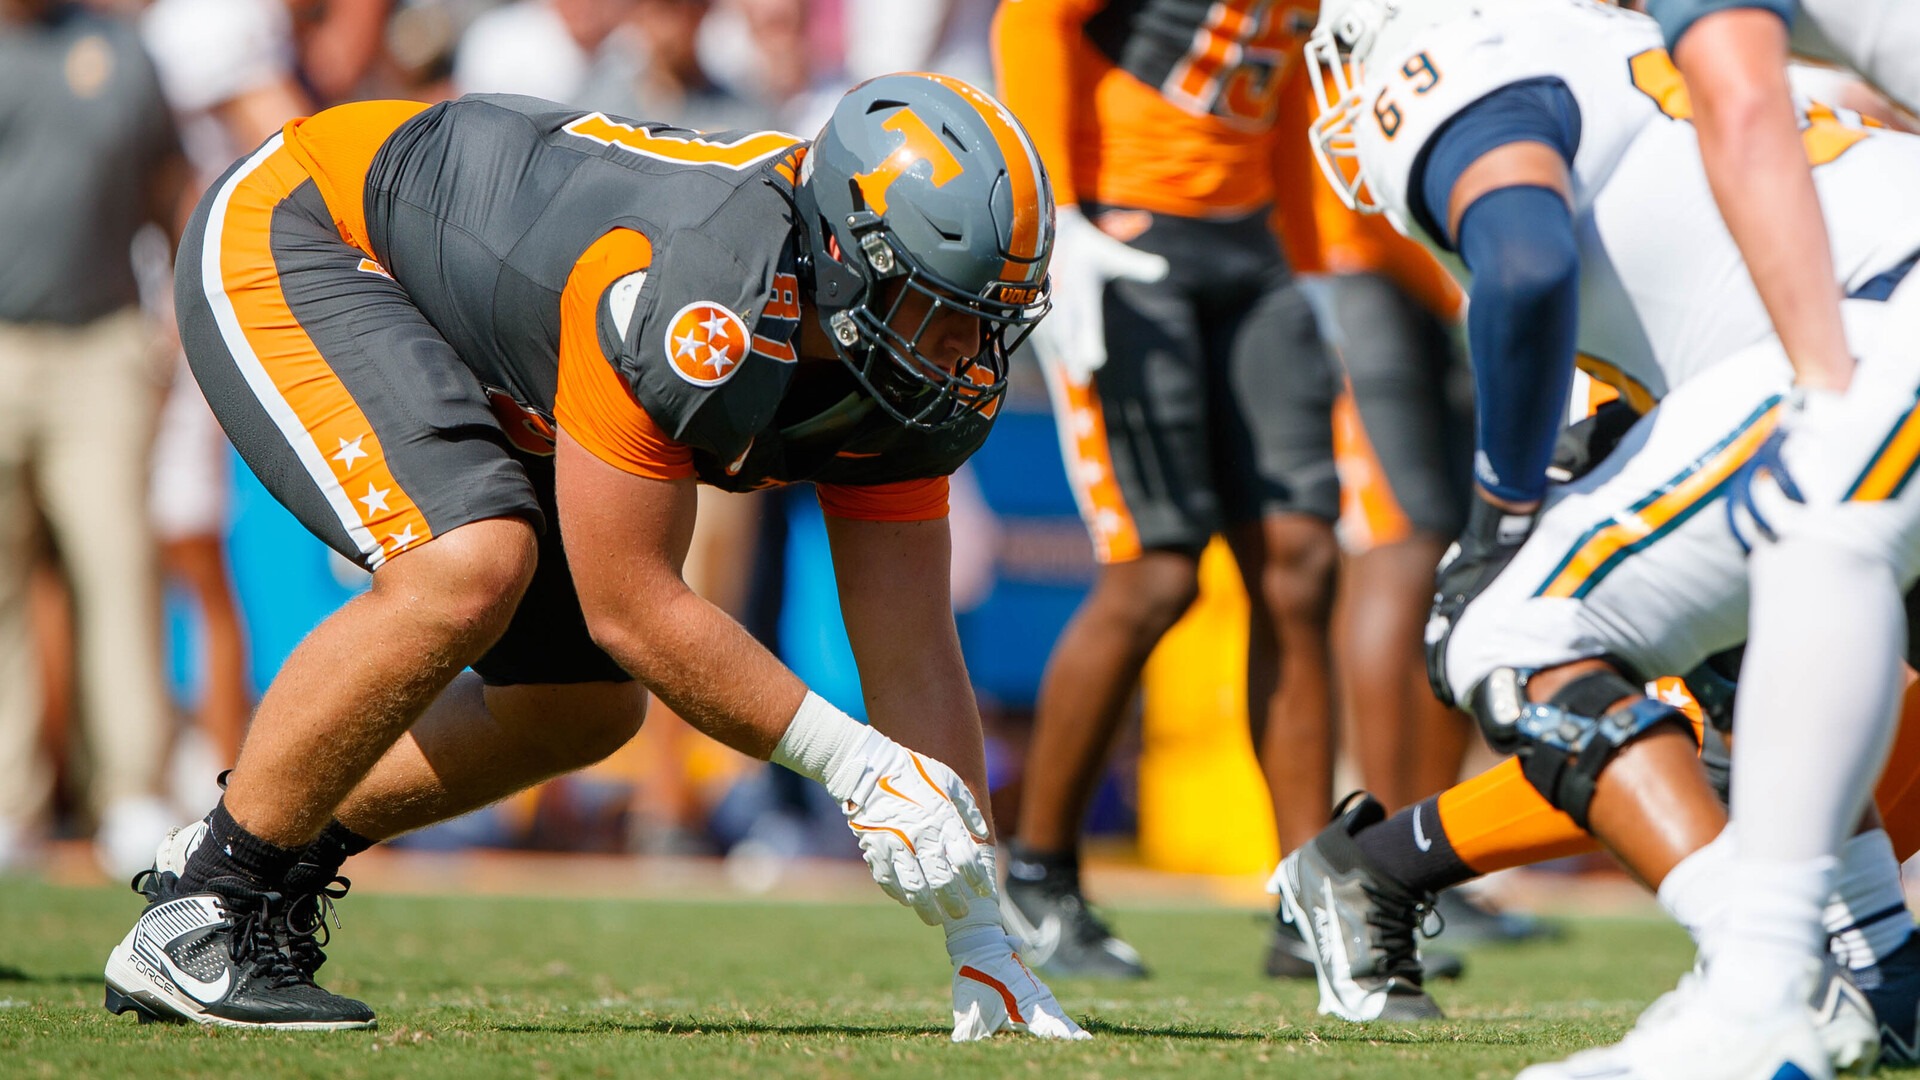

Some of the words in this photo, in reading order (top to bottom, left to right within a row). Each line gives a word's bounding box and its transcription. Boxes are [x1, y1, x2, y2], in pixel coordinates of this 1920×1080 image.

[1373, 50, 1443, 142] 69
[851, 107, 964, 217] T
[752, 272, 800, 363] 81
[1000, 286, 1038, 305] VOLS
[127, 953, 175, 996] FORCE
